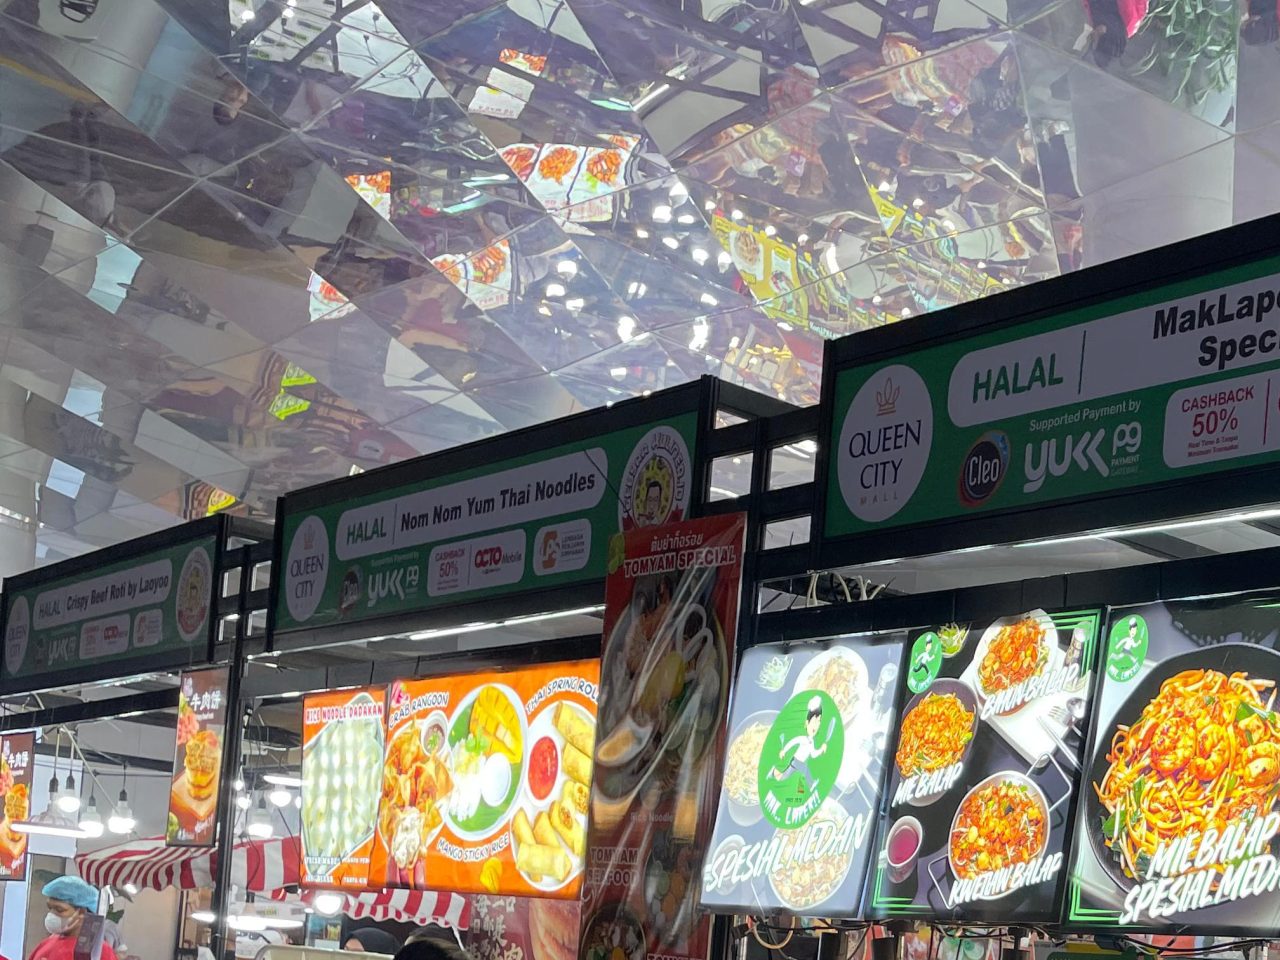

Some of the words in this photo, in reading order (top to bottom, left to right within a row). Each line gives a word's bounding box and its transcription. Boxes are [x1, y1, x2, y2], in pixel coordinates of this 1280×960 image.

[972, 353, 1063, 403] HALAL
[1029, 410, 1080, 432] Supported
[1082, 401, 1126, 421] Payment
[1128, 399, 1141, 414] by
[1181, 385, 1255, 413] CASHBACK
[1192, 406, 1238, 437] 50%
[849, 420, 922, 458] QUEEN
[860, 458, 903, 490] CITY
[966, 454, 1000, 487] Cleo
[346, 516, 388, 545] HALAL
[400, 511, 428, 532] Nom
[433, 505, 461, 525] Nom
[467, 494, 495, 517] Yum
[500, 484, 530, 509] Thai
[534, 472, 596, 500] Noodles
[290, 554, 324, 578] QUEEN
[439, 560, 459, 578] 50%
[474, 546, 502, 568] OCTO
[624, 552, 676, 578] TOMYAM
[677, 545, 736, 570] SPECIAL
[66, 593, 88, 611] Crispy
[91, 586, 109, 604] Beef
[110, 583, 126, 600] Roti
[128, 582, 138, 598] by
[295, 580, 315, 599] CITY
[389, 704, 411, 729] CRAB
[410, 692, 449, 716] RANGOON
[526, 690, 546, 714] THAI
[546, 677, 578, 699] SPRING
[306, 708, 321, 724] RICE
[322, 705, 348, 722] NOODLE
[892, 777, 921, 808] MIE
[918, 762, 964, 797] BALAP
[438, 838, 464, 861] MANGO
[464, 843, 491, 863] STICKY
[490, 832, 510, 854] RICE
[590, 846, 640, 865] TOMYAM
[704, 831, 792, 893] SPESIAL
[791, 811, 872, 862] MEDAN
[1146, 833, 1199, 876] MIE
[1197, 812, 1280, 867] BALAP
[1012, 852, 1063, 888] BALAP
[1118, 870, 1223, 924] SPESIAL
